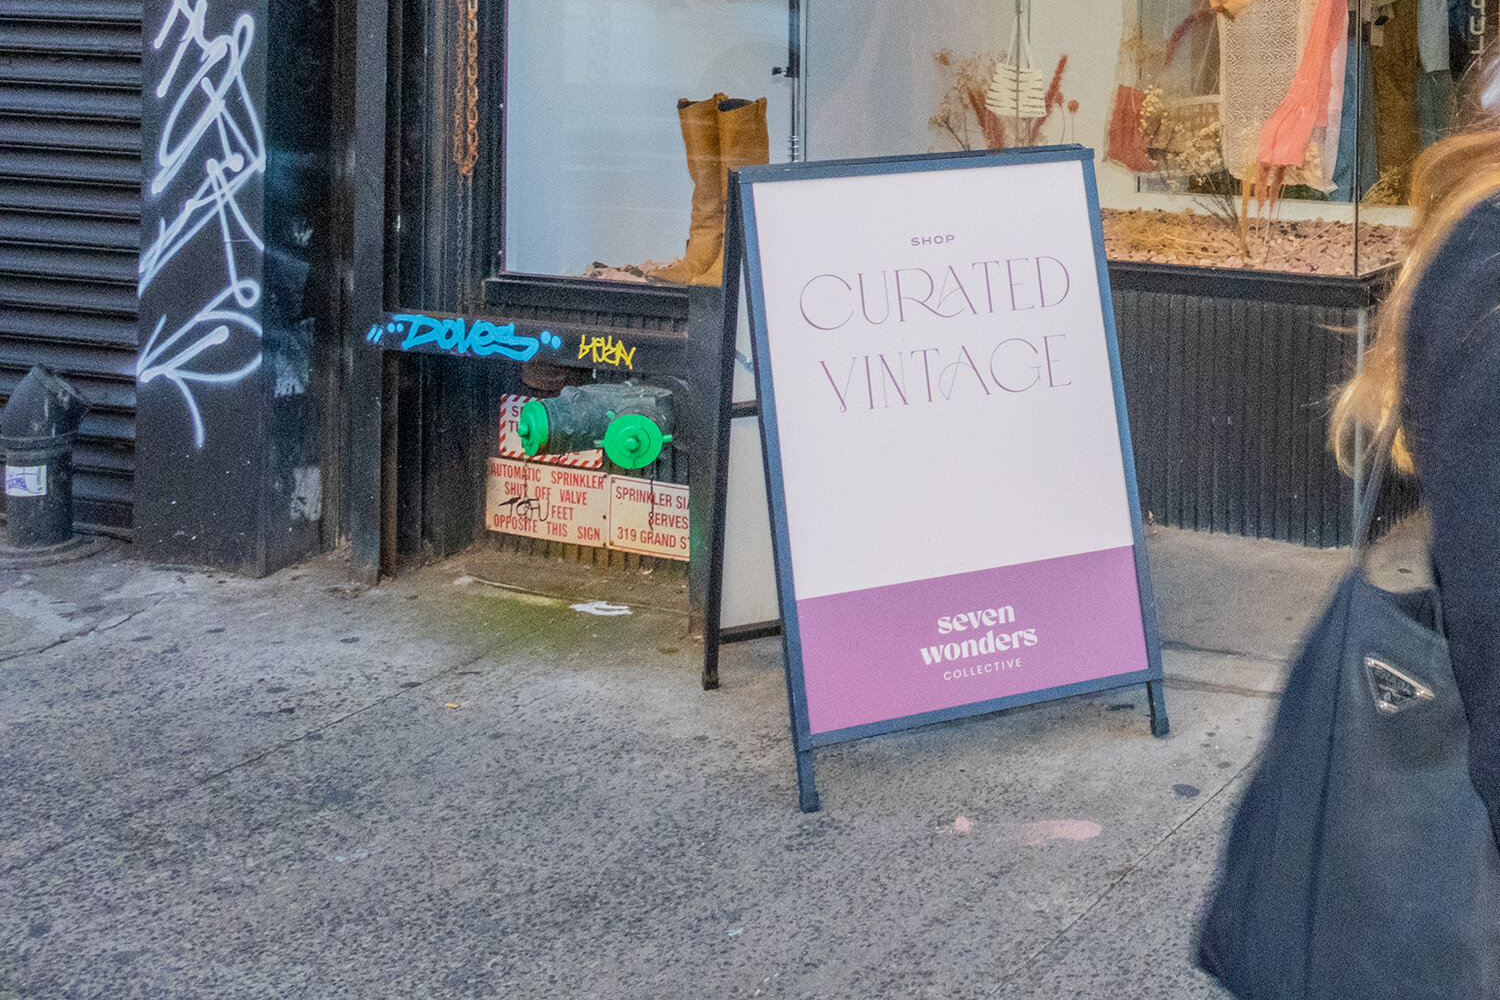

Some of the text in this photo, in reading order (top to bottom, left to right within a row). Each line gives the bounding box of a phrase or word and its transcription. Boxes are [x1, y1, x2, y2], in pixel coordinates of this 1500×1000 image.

[910, 234, 955, 247] SHOP
[799, 255, 1070, 331] CURATED
[819, 334, 1072, 414] VINTAGE
[490, 463, 605, 490] AUTOMATIC SPRINKLER
[504, 481, 588, 506] SHUT OFF VALVE
[615, 486, 673, 509] SPRINKLER
[551, 507, 574, 521] FEET
[648, 511, 689, 530] SERVES
[493, 513, 600, 541] OPPOSITE THIS SIGN
[617, 526, 637, 542] 319
[640, 530, 677, 549] GRAND
[937, 605, 1015, 635] seven
[920, 628, 1038, 666] wonders
[943, 657, 1022, 681] COLLECTIVE
